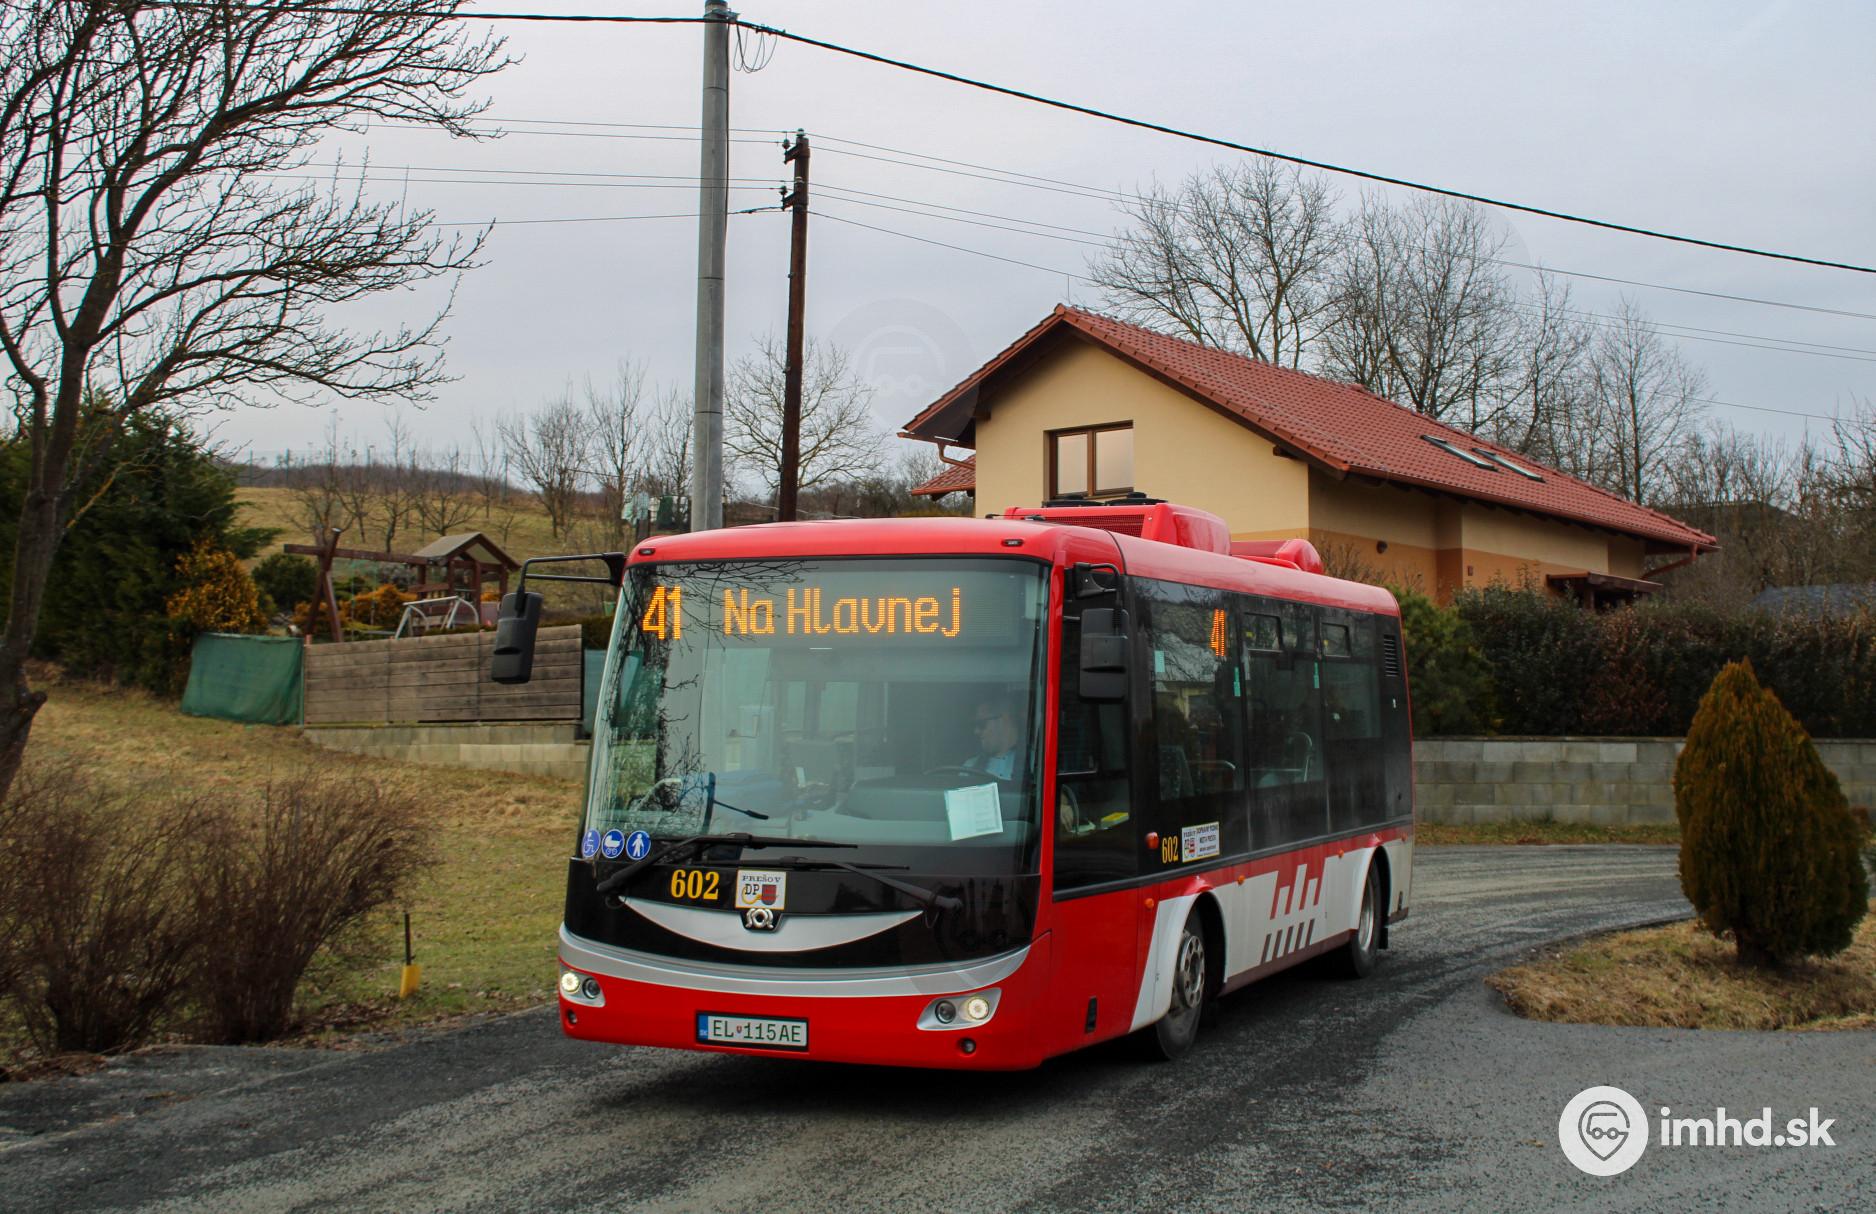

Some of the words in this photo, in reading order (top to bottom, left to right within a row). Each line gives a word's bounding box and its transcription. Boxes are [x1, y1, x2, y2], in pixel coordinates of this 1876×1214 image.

[642, 585, 681, 640] 41
[724, 587, 775, 634] Na
[787, 586, 961, 637] Hlavnej
[1210, 608, 1225, 657] 41
[1162, 836, 1179, 864] 602
[671, 869, 720, 900] 602
[745, 883, 760, 895] DP
